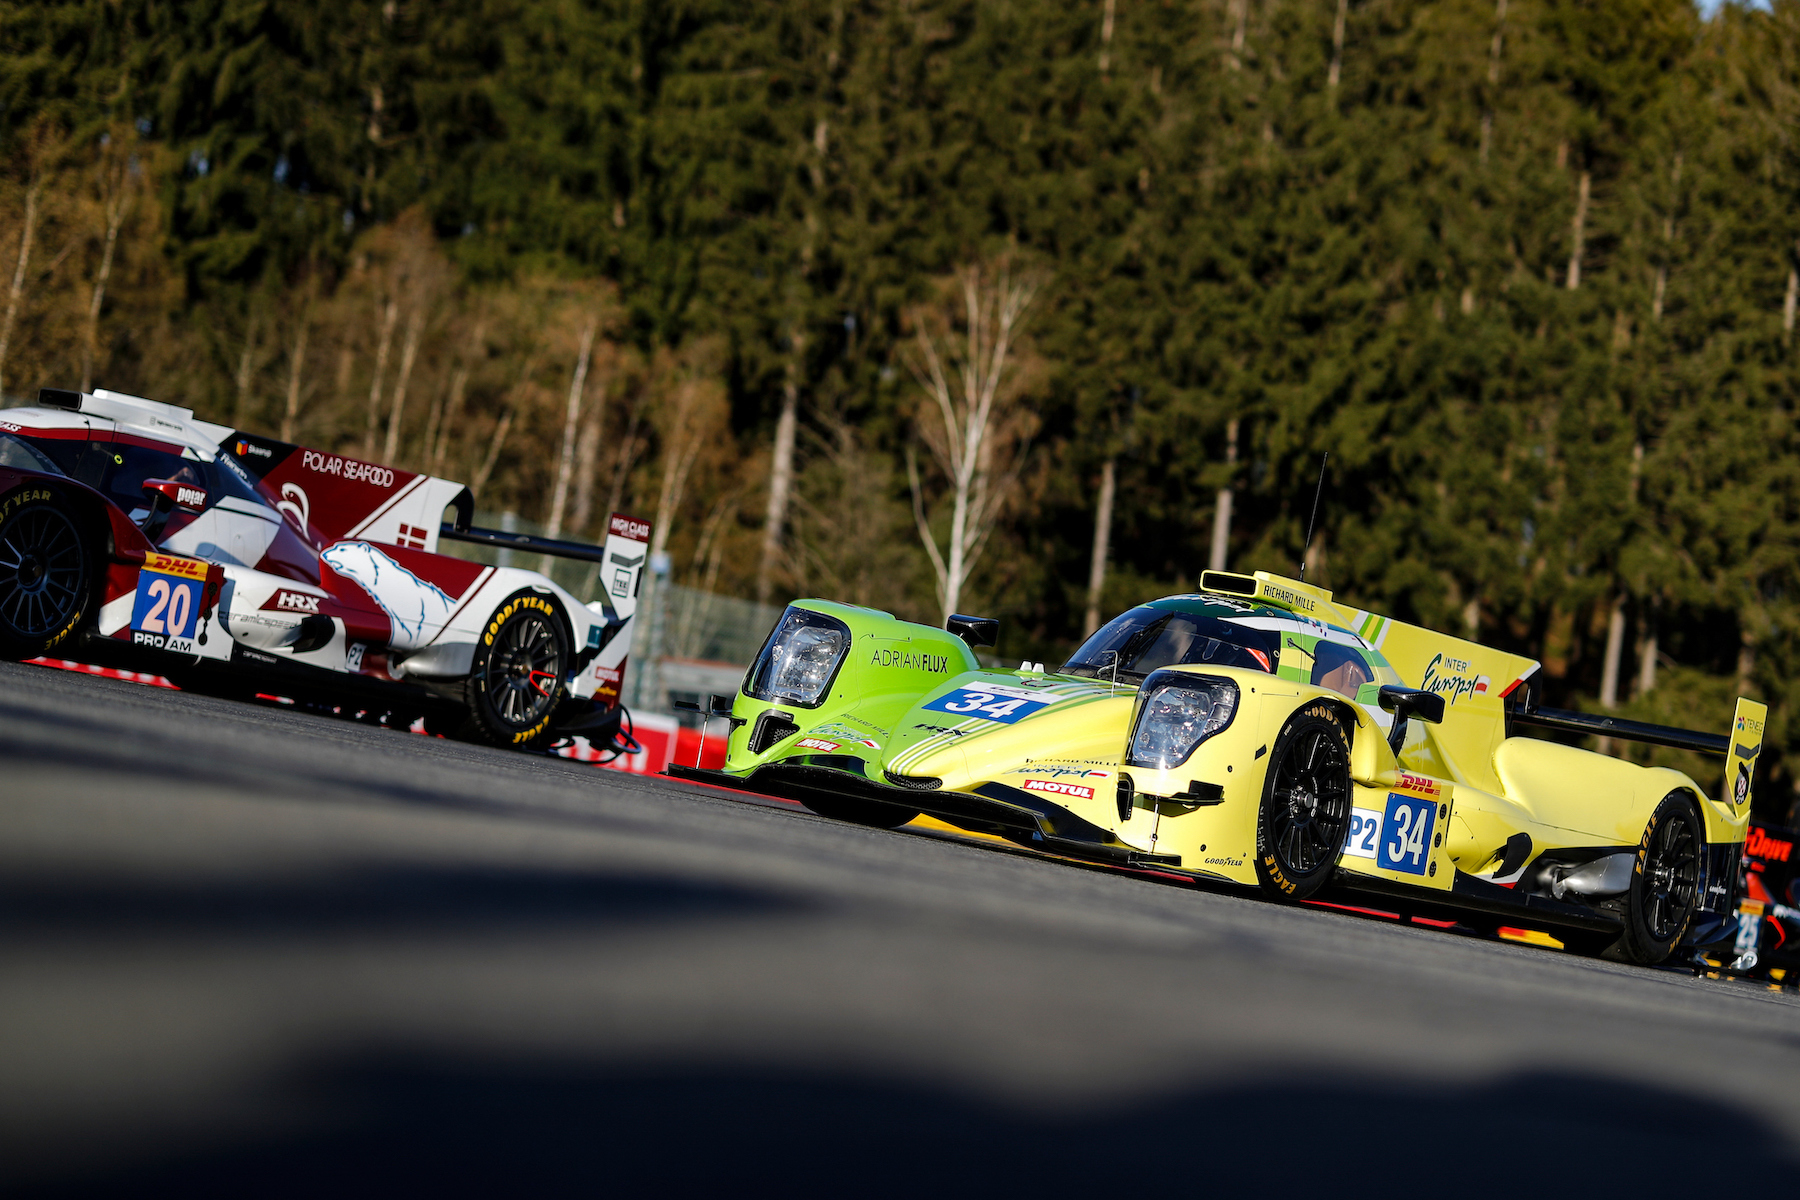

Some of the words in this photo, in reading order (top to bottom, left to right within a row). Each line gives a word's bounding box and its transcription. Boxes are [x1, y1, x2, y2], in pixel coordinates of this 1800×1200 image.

[302, 450, 343, 476] POLAR
[343, 460, 394, 488] SEAFOOD
[176, 487, 206, 506] polar
[153, 556, 198, 576] DHL
[141, 579, 191, 637] 20
[277, 592, 320, 612] HRX
[1263, 584, 1294, 604] RICHARD
[1294, 595, 1316, 612] MILLE
[43, 610, 81, 651] EAGLE
[484, 597, 554, 646] GOODYEAR
[134, 632, 165, 648] PRO
[169, 640, 192, 652] AM
[348, 645, 366, 666] P2
[1444, 657, 1467, 673] INTER
[944, 692, 1028, 719] 34
[512, 714, 550, 744] EAGLE
[1746, 718, 1764, 733] TENEG
[797, 738, 838, 752] MOTUL
[1026, 780, 1092, 798] MOTUL
[1401, 774, 1436, 795] DHL
[1388, 804, 1428, 866] 34
[1635, 814, 1657, 876] EAGLE
[1204, 856, 1244, 868] GOODYEAR
[1264, 854, 1297, 895] EAGLE
[1736, 913, 1760, 949] 25
